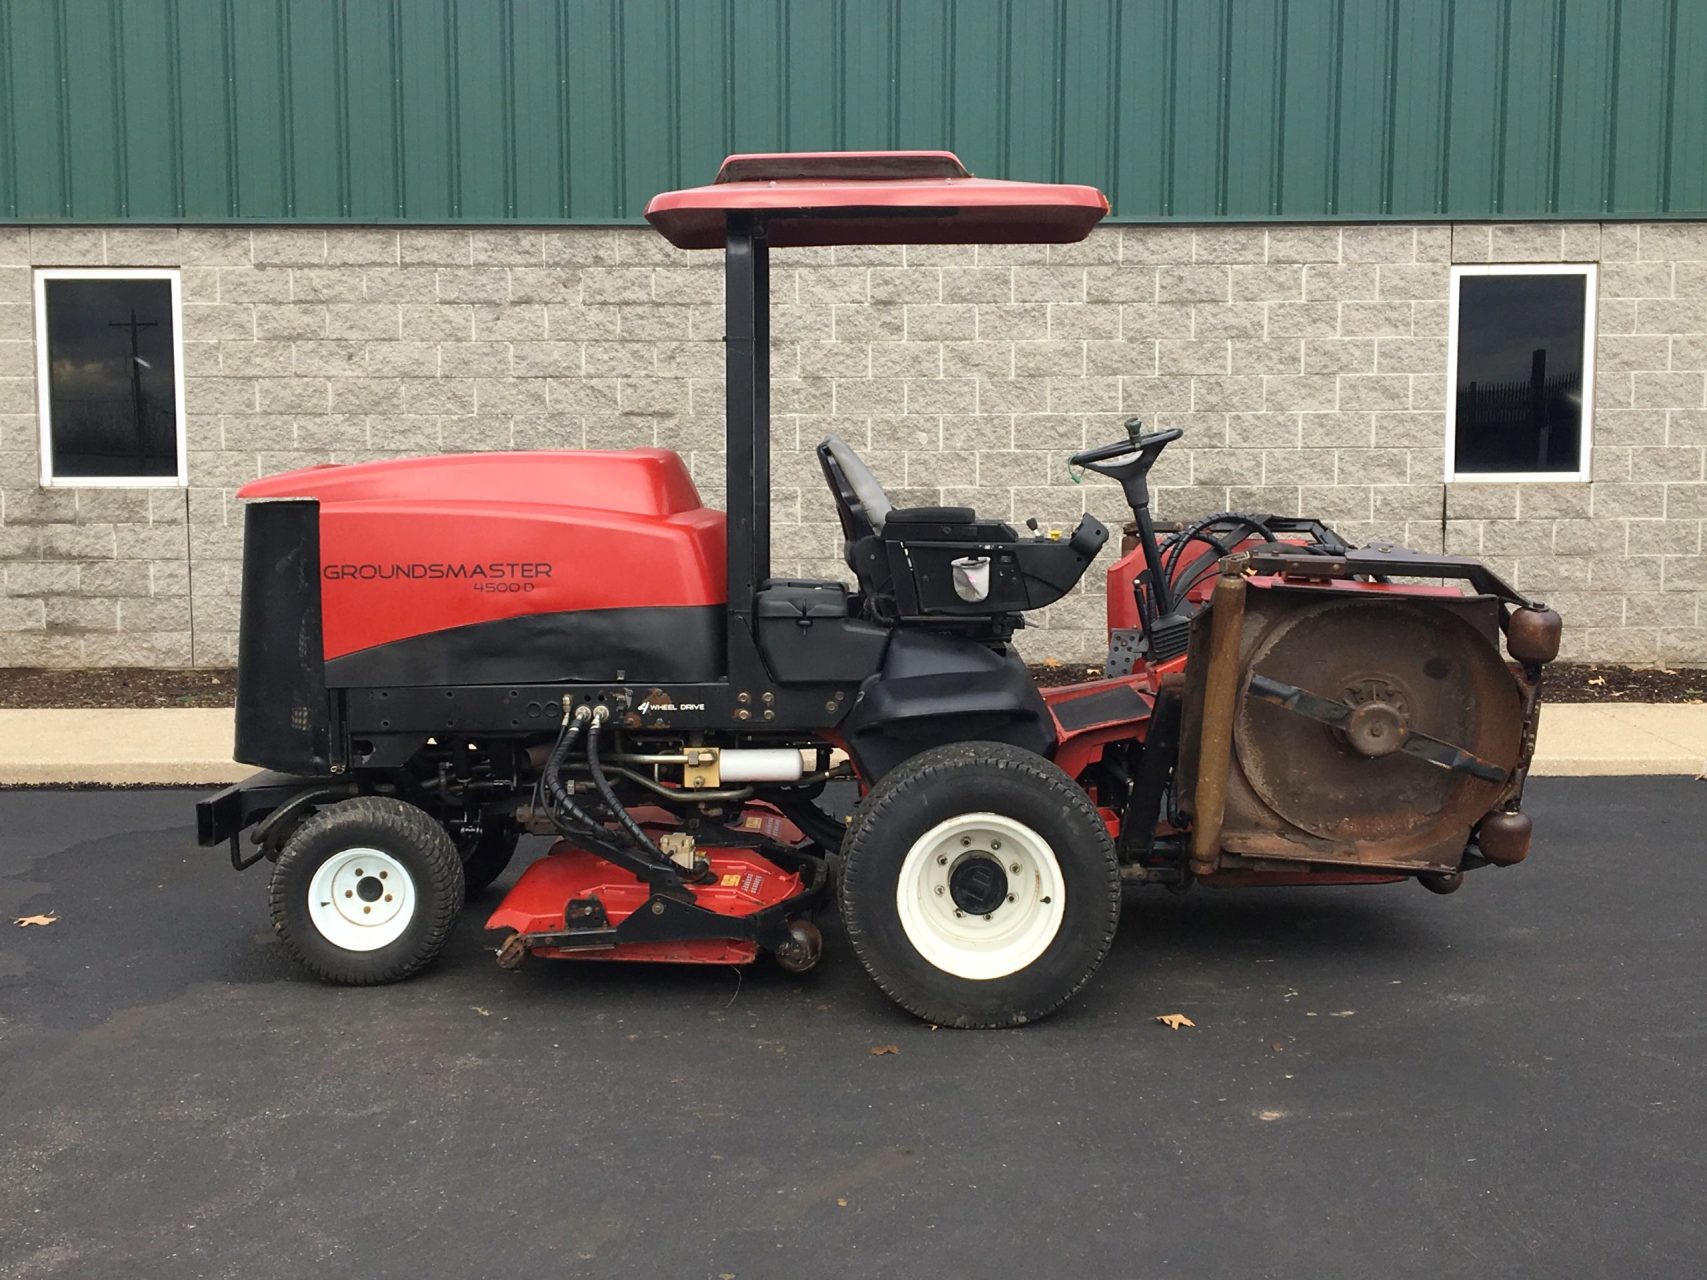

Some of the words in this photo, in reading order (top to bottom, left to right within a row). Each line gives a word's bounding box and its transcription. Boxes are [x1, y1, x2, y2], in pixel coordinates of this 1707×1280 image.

[323, 563, 553, 580] GROUNDSMASTER
[637, 701, 650, 715] 4
[680, 703, 705, 711] DRIVE
